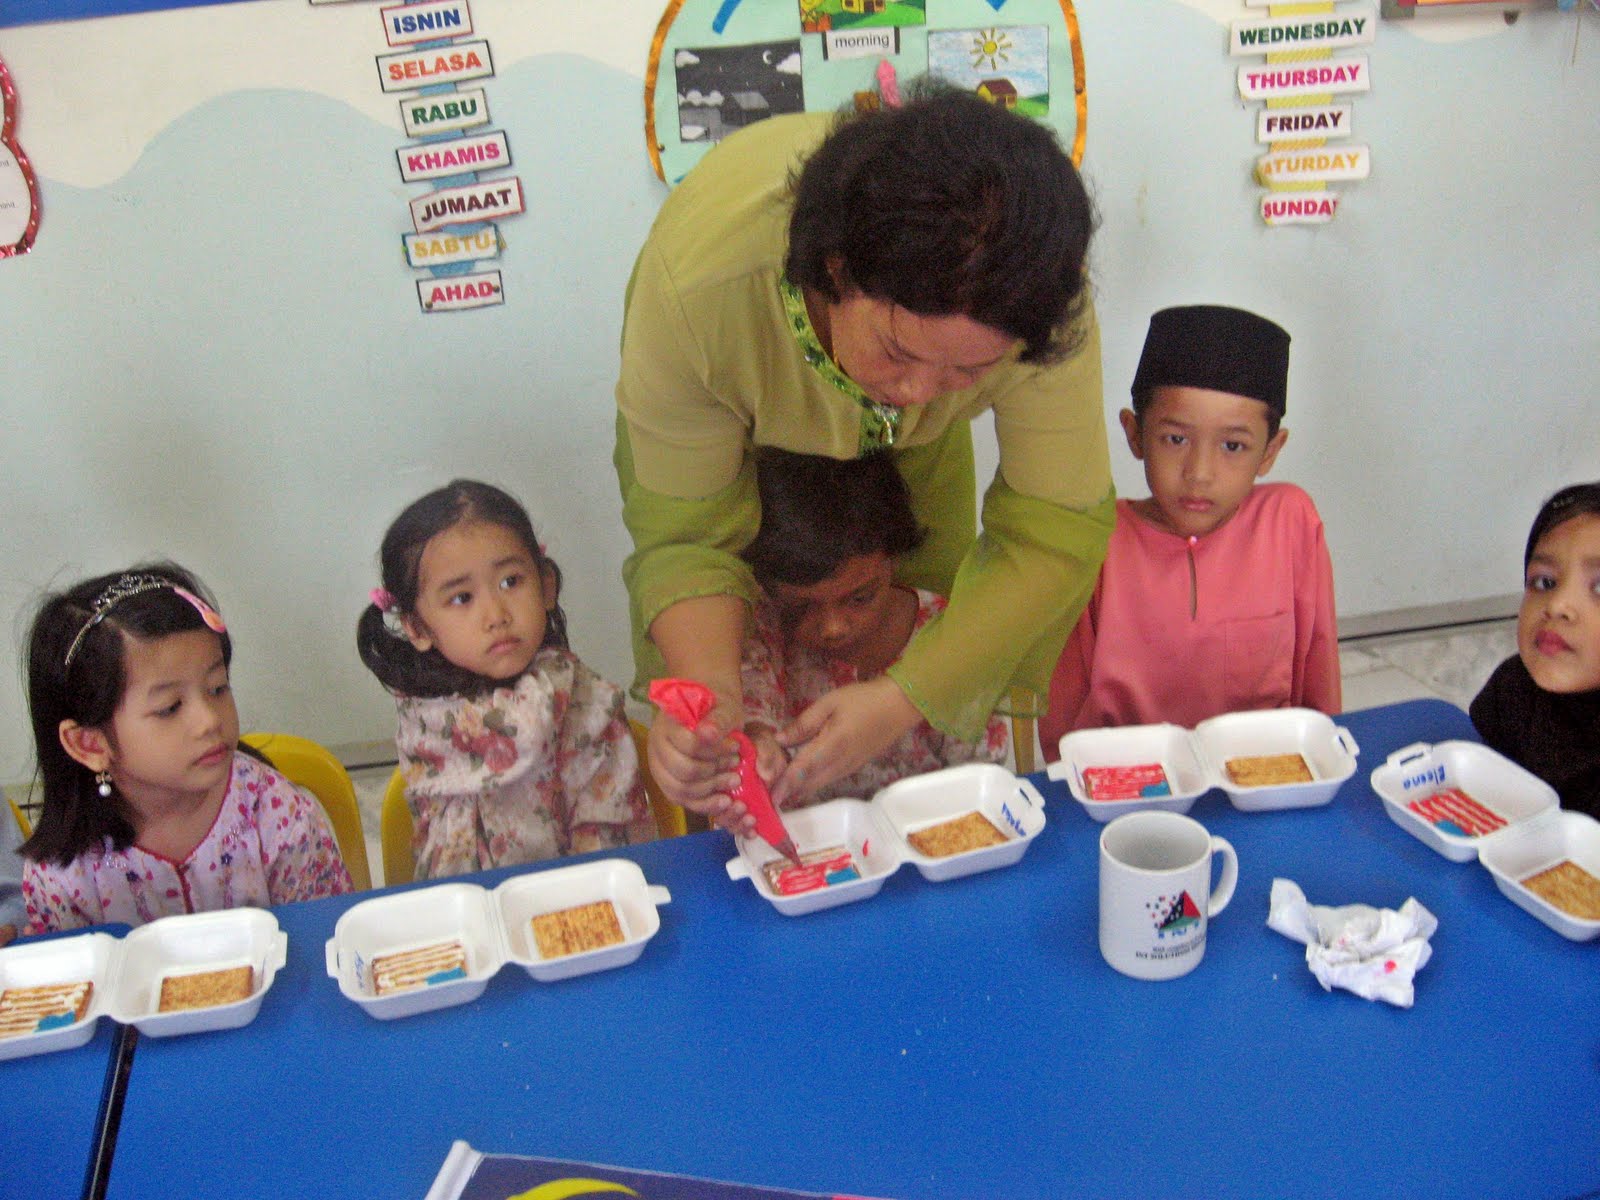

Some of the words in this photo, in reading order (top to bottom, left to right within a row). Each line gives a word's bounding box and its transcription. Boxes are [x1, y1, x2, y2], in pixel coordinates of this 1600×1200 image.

[394, 9, 461, 34] ISNIN
[1239, 18, 1366, 46] WEDNESDAY
[834, 33, 889, 48] morning
[388, 51, 482, 81] SELASA
[1247, 64, 1361, 90] THURSDAY
[411, 98, 478, 125] RABU
[1266, 112, 1343, 133] FRIDAY
[407, 142, 500, 172] KHAMIS
[1263, 153, 1360, 176] ATURDAY
[421, 188, 512, 222] JUMAAT
[413, 233, 490, 258] SABTU
[430, 281, 494, 303] AHAD
